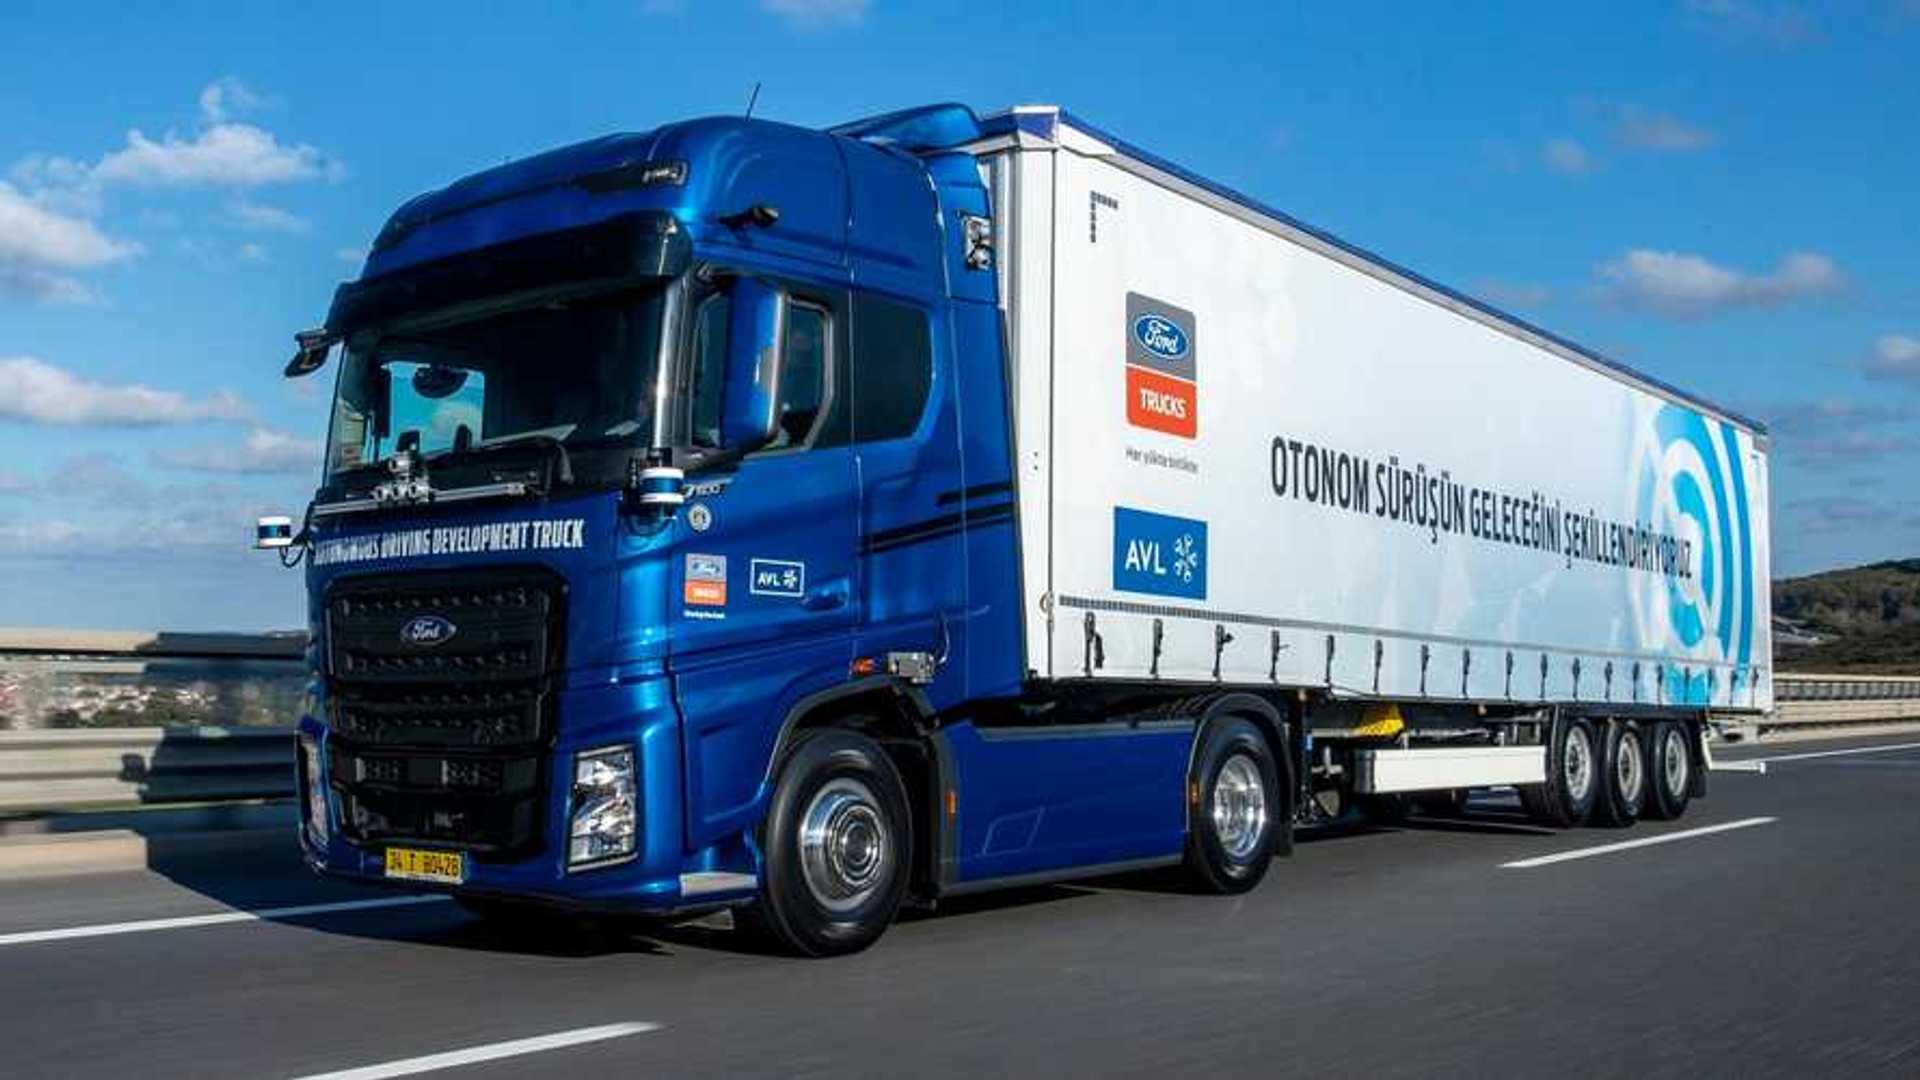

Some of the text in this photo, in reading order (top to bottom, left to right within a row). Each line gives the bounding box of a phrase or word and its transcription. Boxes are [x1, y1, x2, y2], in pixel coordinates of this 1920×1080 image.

[1144, 319, 1179, 354] Ford
[1139, 387, 1188, 419] TRUCKS
[1271, 436, 1370, 515] OTONOM
[1375, 456, 1466, 544] SÜRÜŞÜN
[379, 529, 431, 559] DRIVING
[432, 521, 530, 555] DEVELOPMENT
[531, 518, 585, 549] TRUCK
[1124, 539, 1167, 575] AVL
[757, 571, 781, 587] AVL
